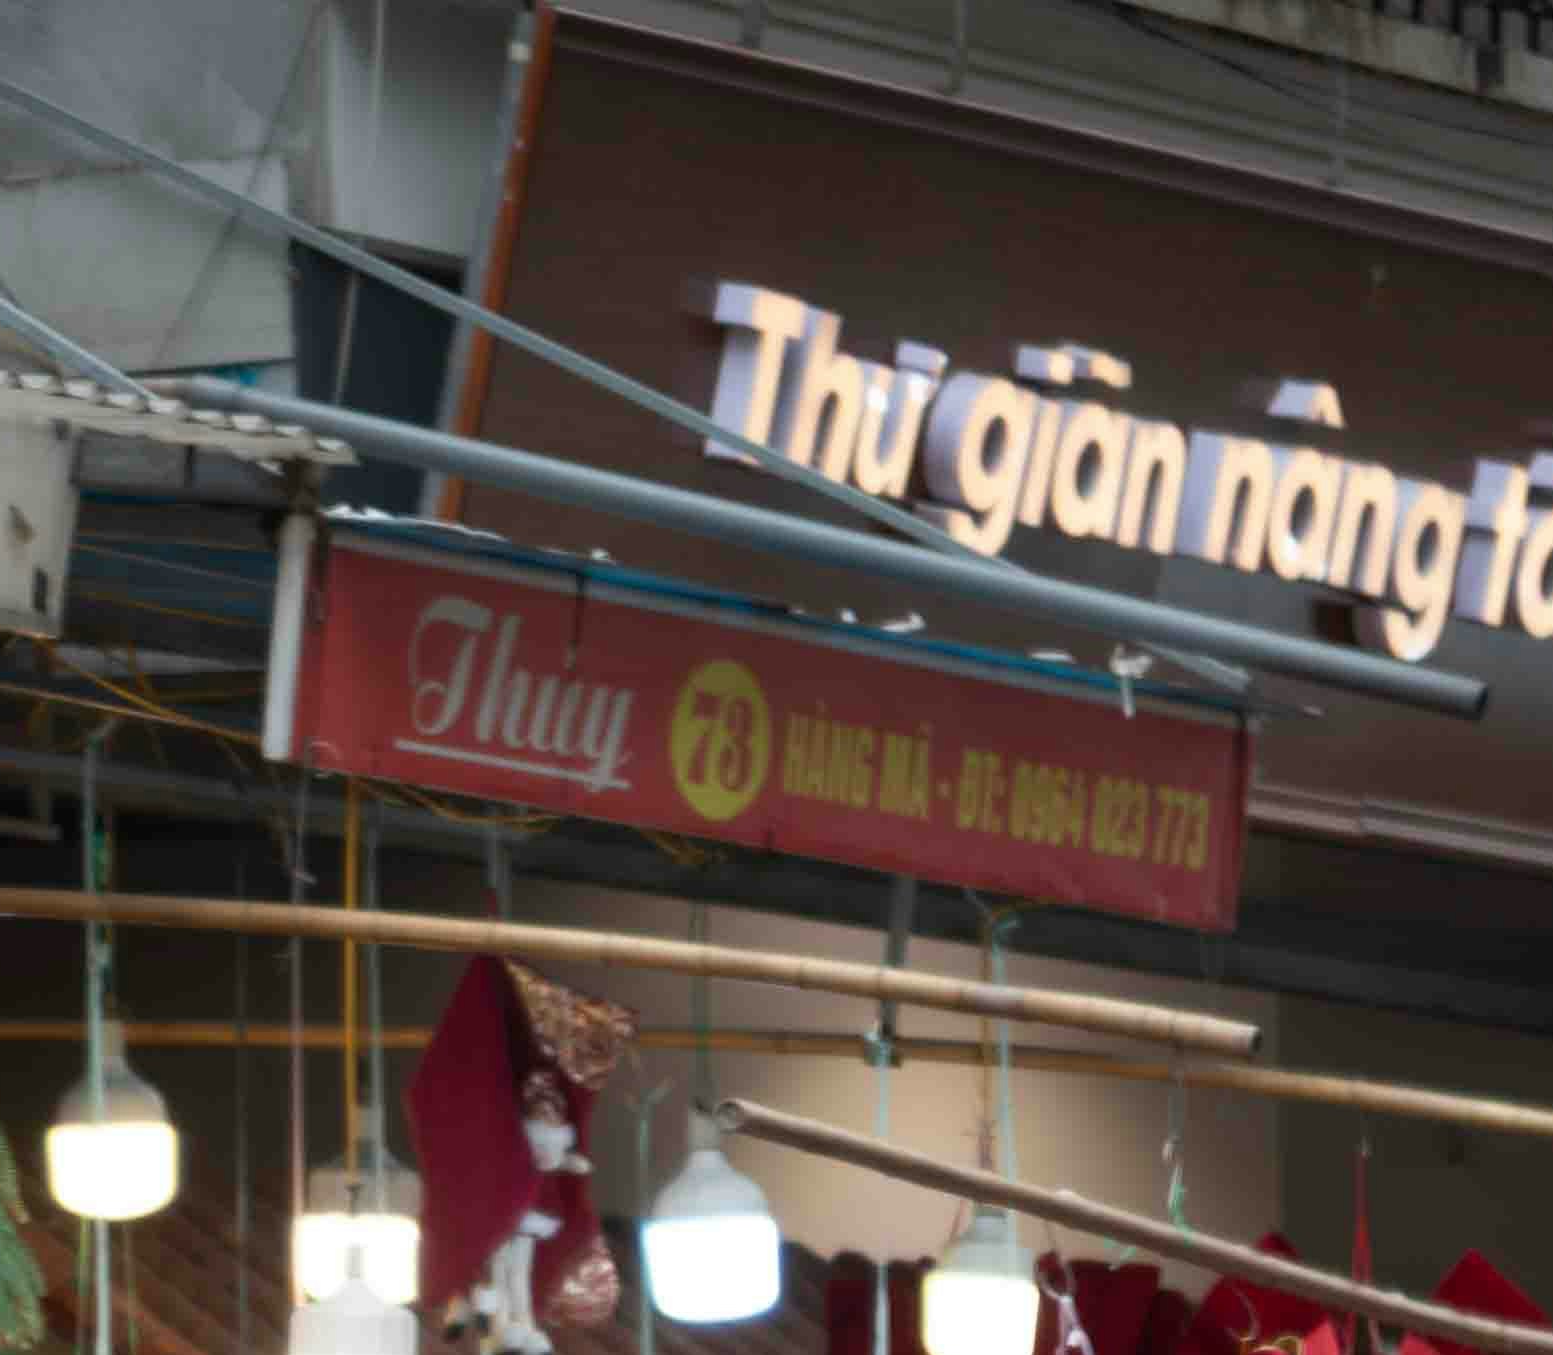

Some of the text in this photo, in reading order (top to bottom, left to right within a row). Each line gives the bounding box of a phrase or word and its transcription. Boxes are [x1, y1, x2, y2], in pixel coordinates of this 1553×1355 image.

[922, 342, 1188, 557] giãn
[1188, 378, 1468, 662] nâng
[691, 688, 754, 795] 73
[782, 698, 874, 810] HÀNG
